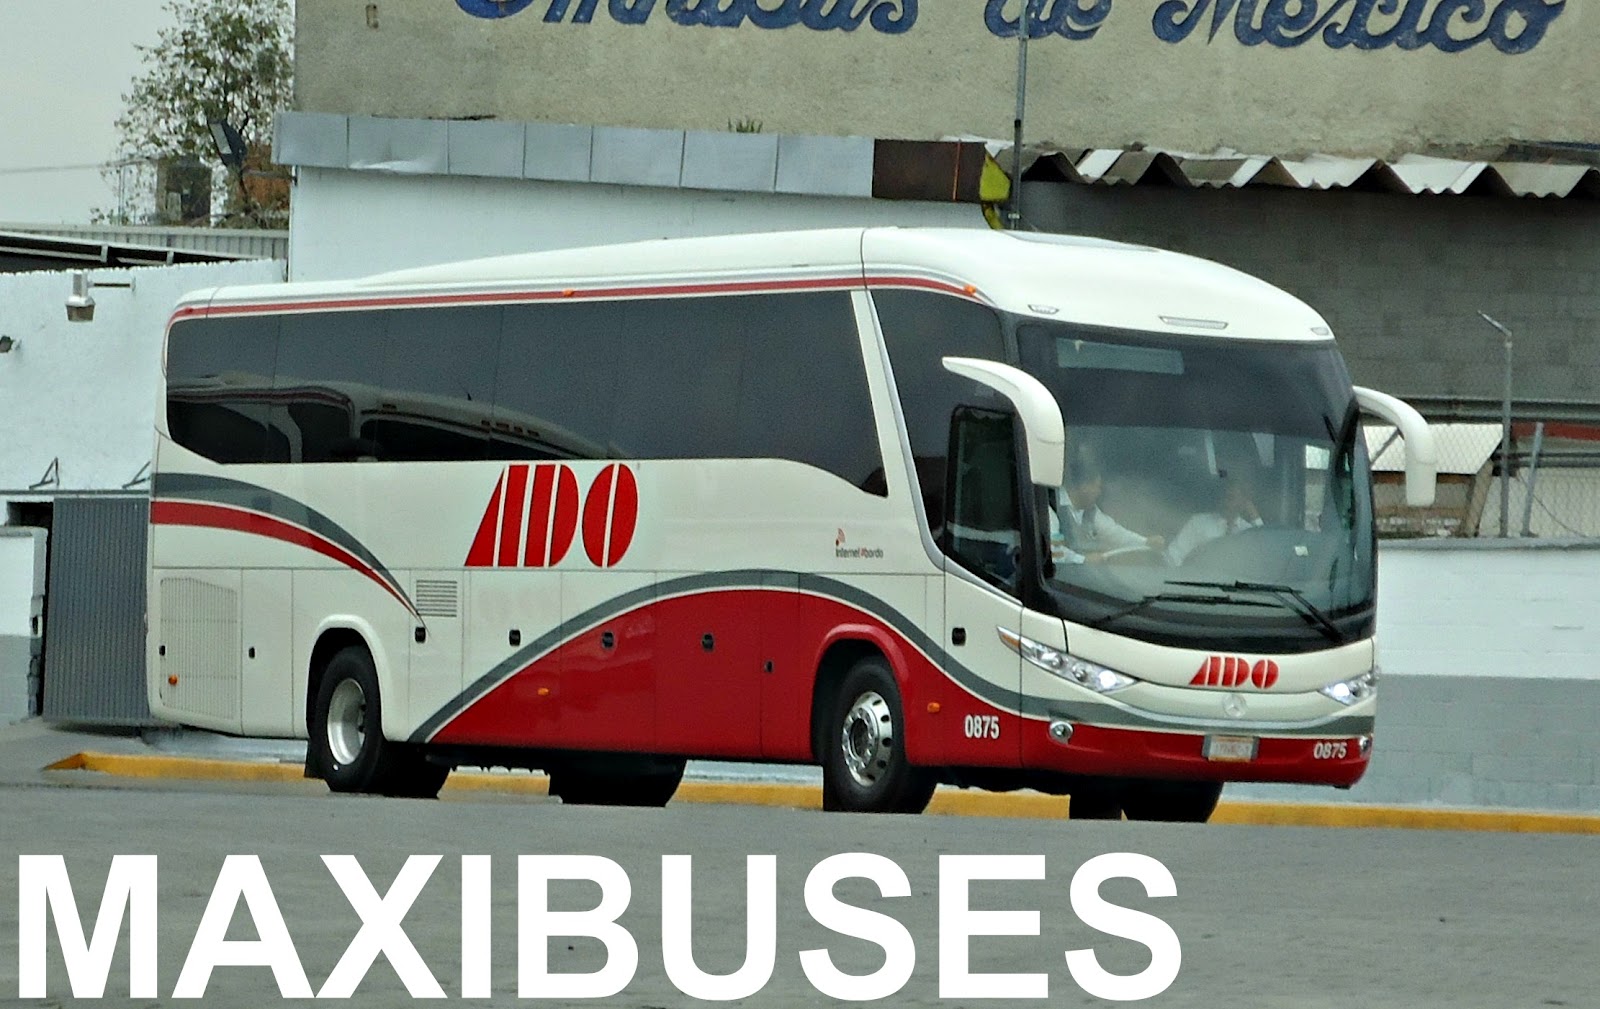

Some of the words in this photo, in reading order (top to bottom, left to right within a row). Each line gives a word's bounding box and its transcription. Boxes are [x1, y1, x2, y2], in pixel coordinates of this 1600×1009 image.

[464, 463, 638, 568] ADO
[1189, 656, 1279, 689] ADO
[964, 714, 1000, 739] 0875
[1313, 742, 1348, 760] 0875
